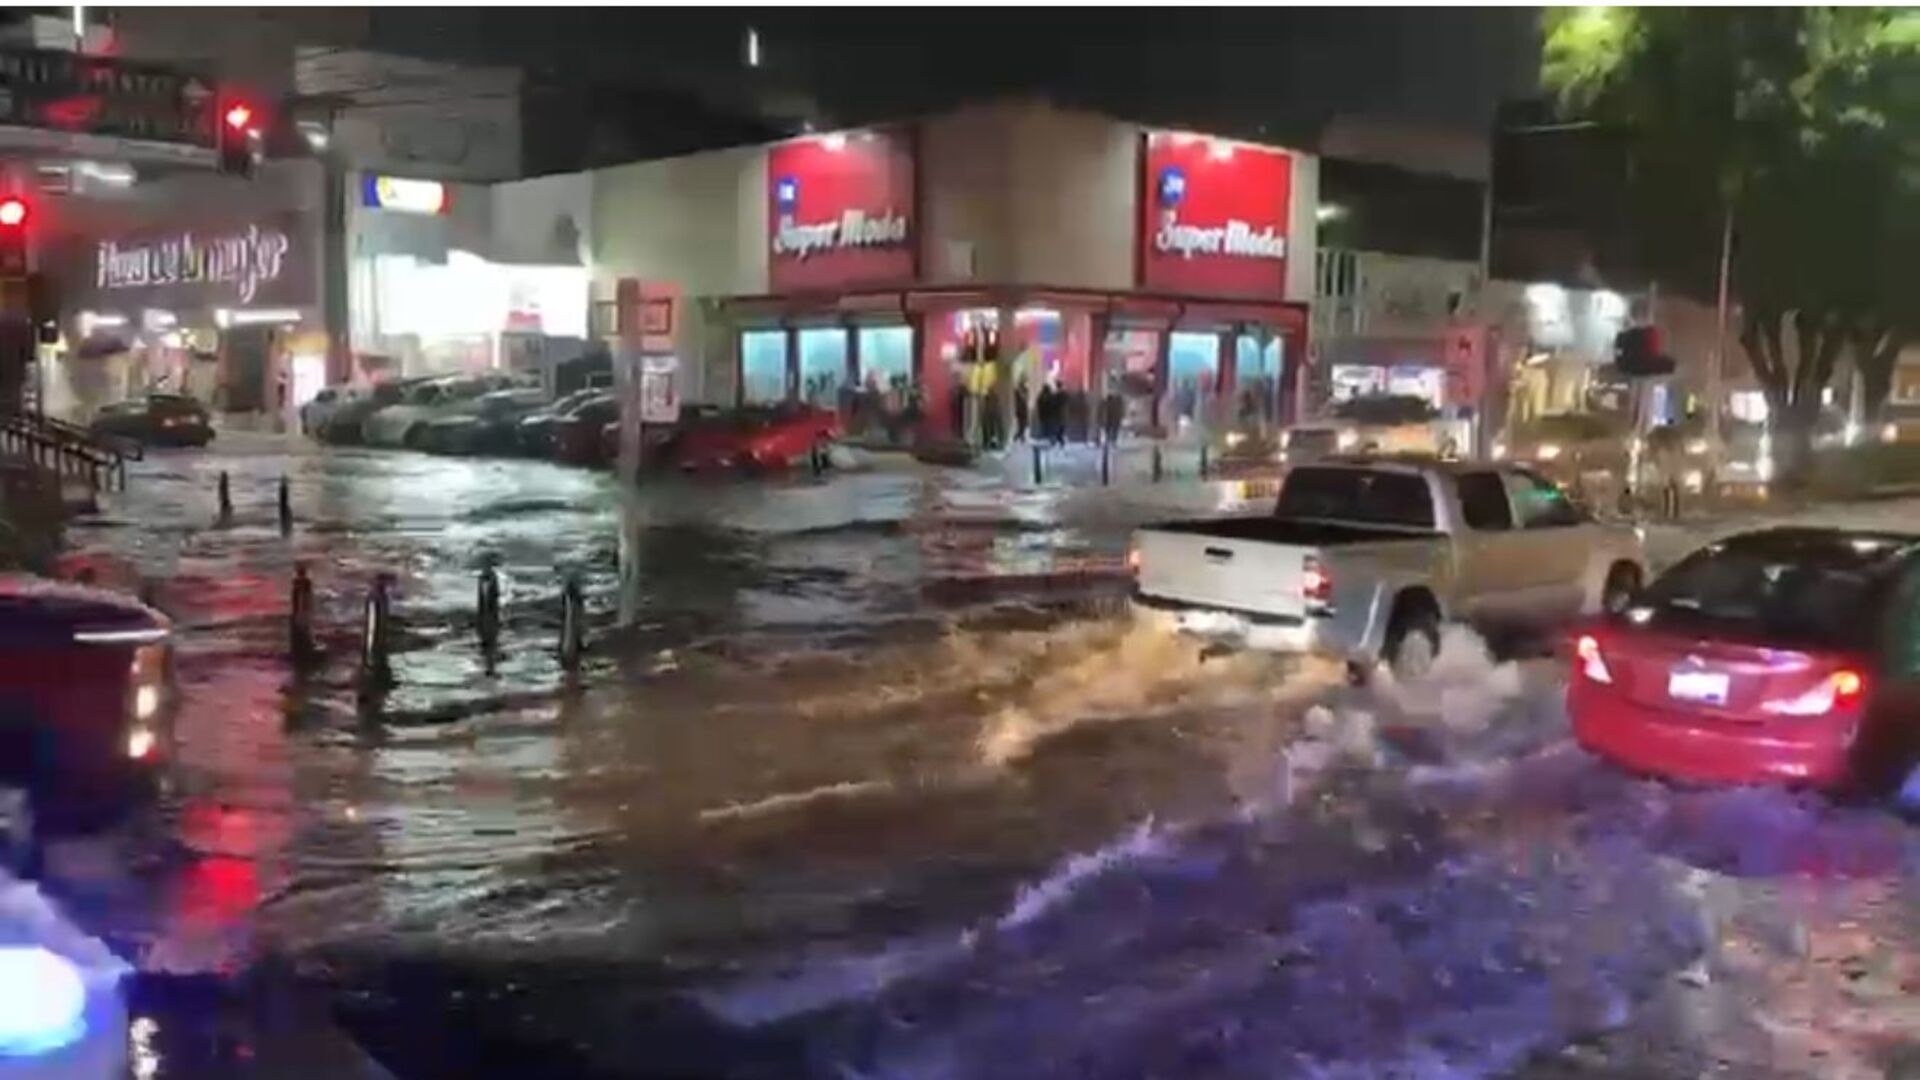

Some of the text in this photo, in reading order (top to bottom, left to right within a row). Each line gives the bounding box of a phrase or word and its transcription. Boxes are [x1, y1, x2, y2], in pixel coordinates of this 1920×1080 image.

[774, 207, 906, 263] Super Moda
[1157, 209, 1286, 260] Super Moda
